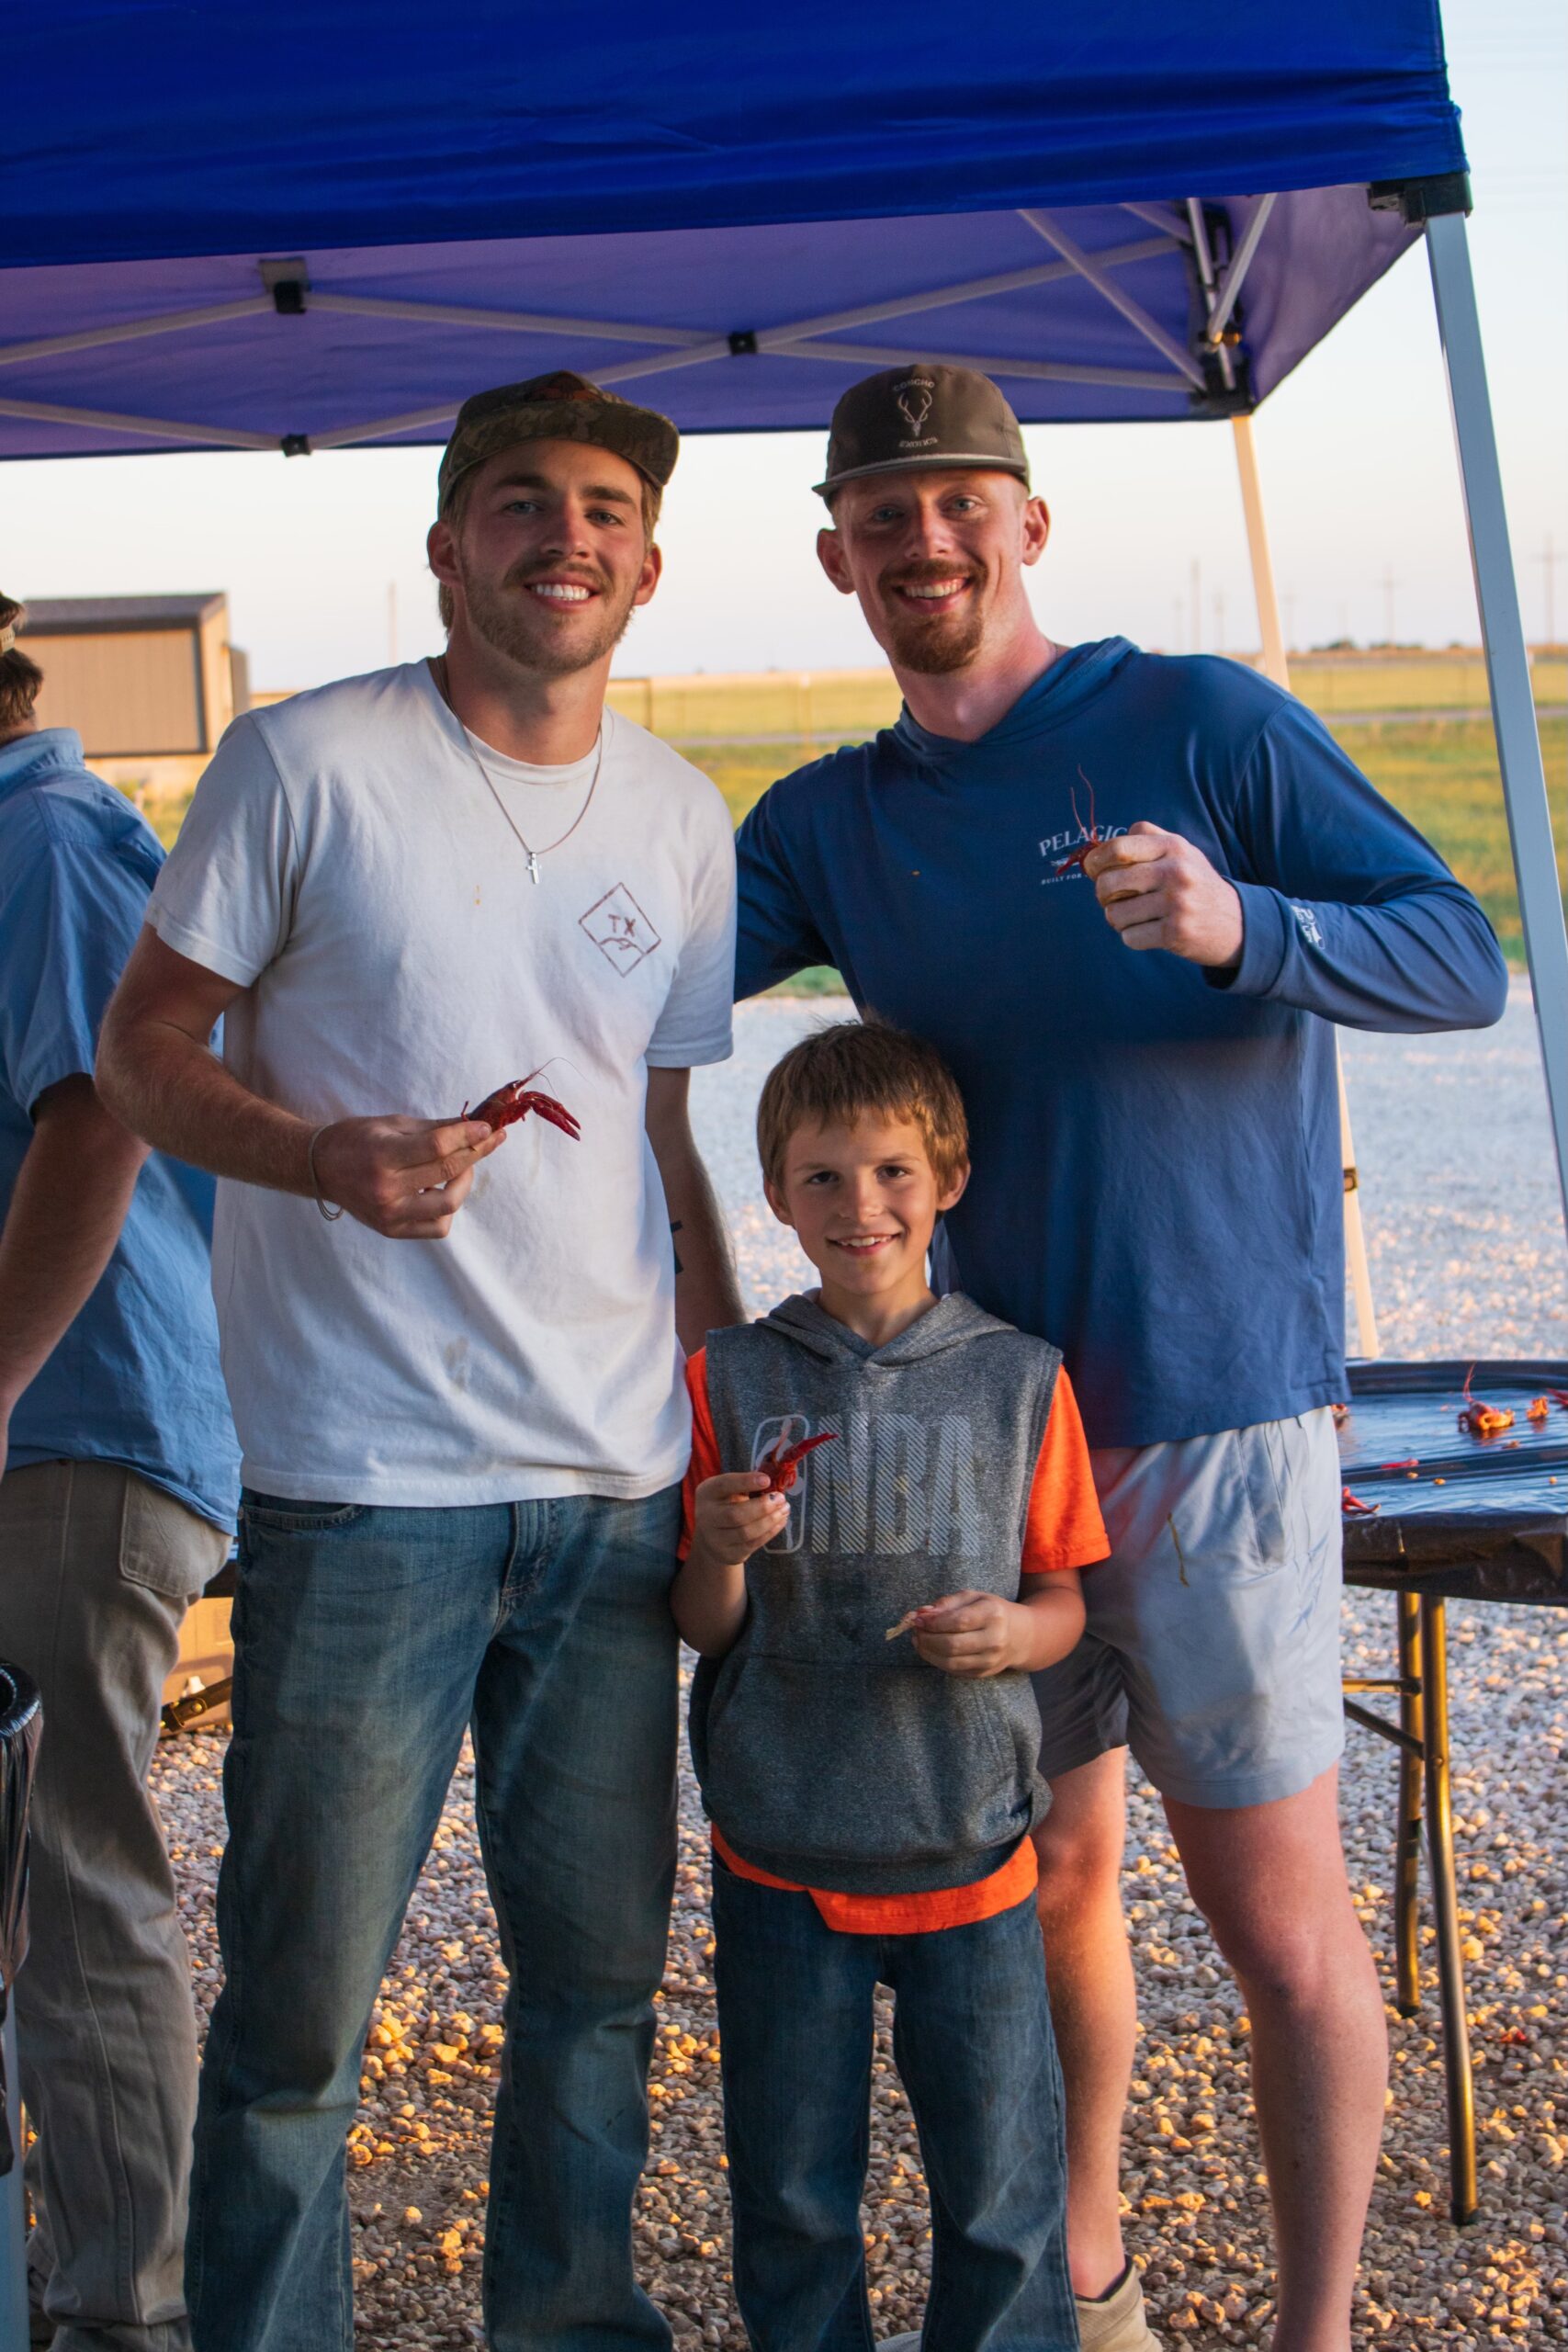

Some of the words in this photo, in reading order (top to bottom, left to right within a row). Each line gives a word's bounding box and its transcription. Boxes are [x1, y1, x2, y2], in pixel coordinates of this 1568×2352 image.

[1041, 876, 1065, 886] BUILT
[607, 914, 636, 937] TX
[811, 1413, 980, 1556] NBA
